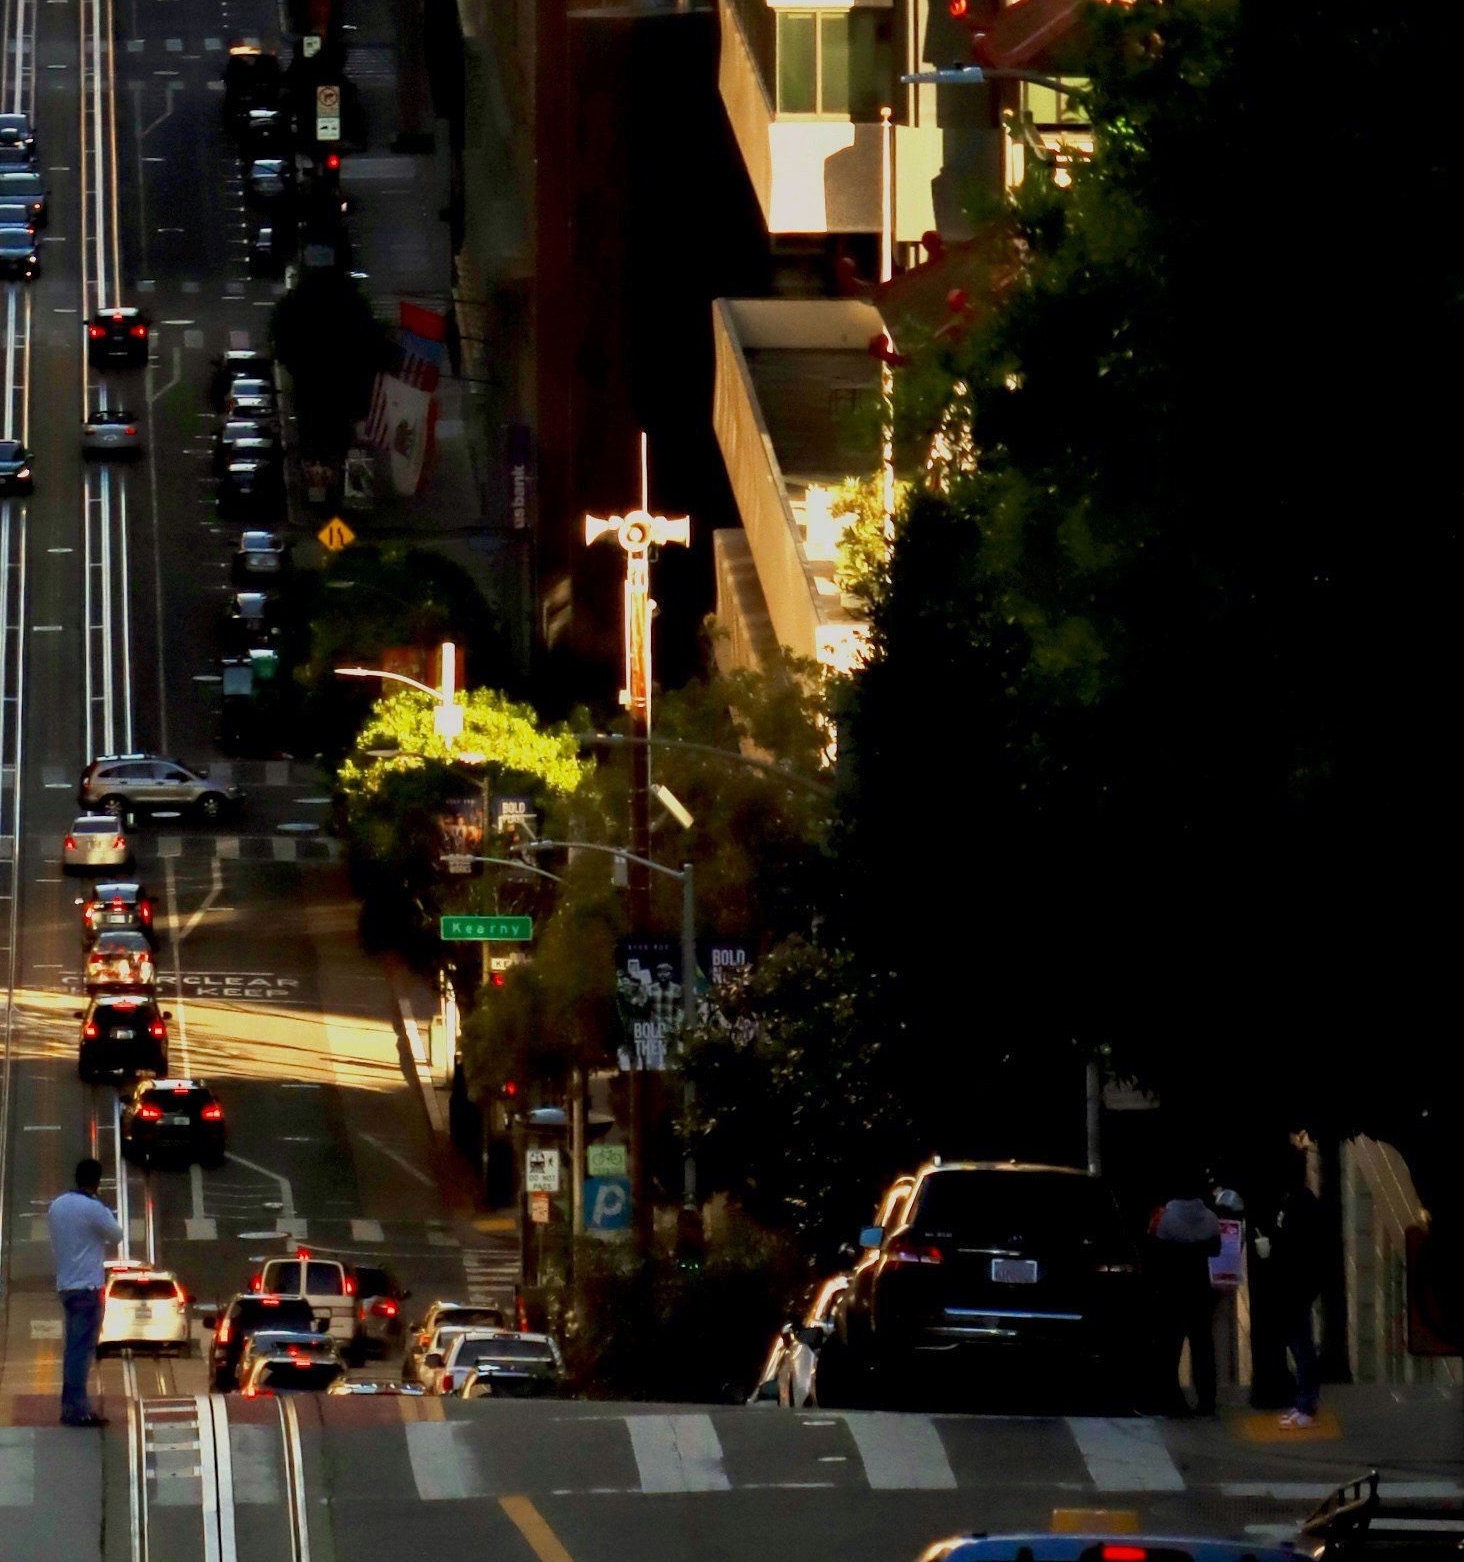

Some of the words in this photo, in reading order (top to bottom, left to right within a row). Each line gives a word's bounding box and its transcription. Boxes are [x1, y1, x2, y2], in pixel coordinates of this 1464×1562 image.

[451, 922, 520, 936] Kearny
[711, 949, 746, 966] BOLD
[182, 976, 299, 988] CLEAR
[196, 987, 290, 997] KEEP
[633, 1022, 666, 1038] BOLD
